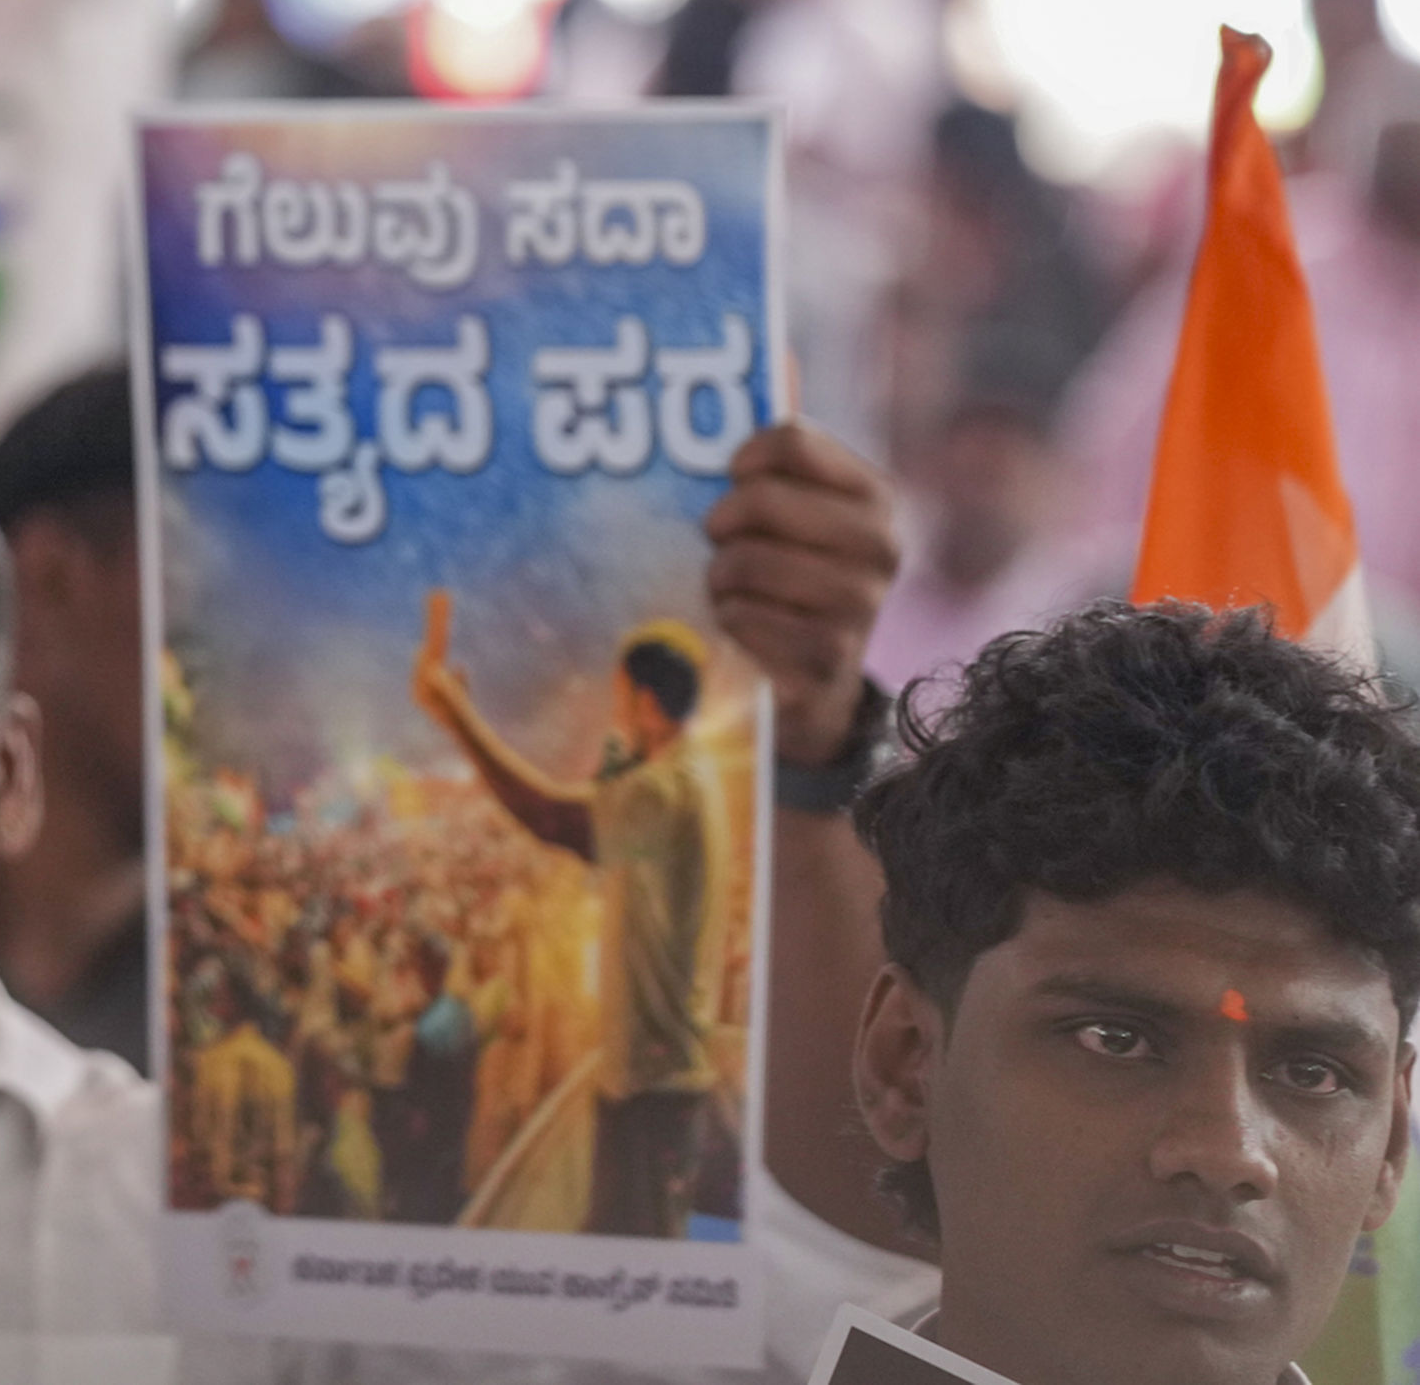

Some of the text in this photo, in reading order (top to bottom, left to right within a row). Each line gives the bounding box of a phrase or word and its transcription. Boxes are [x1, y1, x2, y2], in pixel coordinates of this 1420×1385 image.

[193, 150, 708, 287] ಗೆಲುವು ಸದಾ
[161, 312, 759, 545] ಸತ್ಯದ ಪರ
